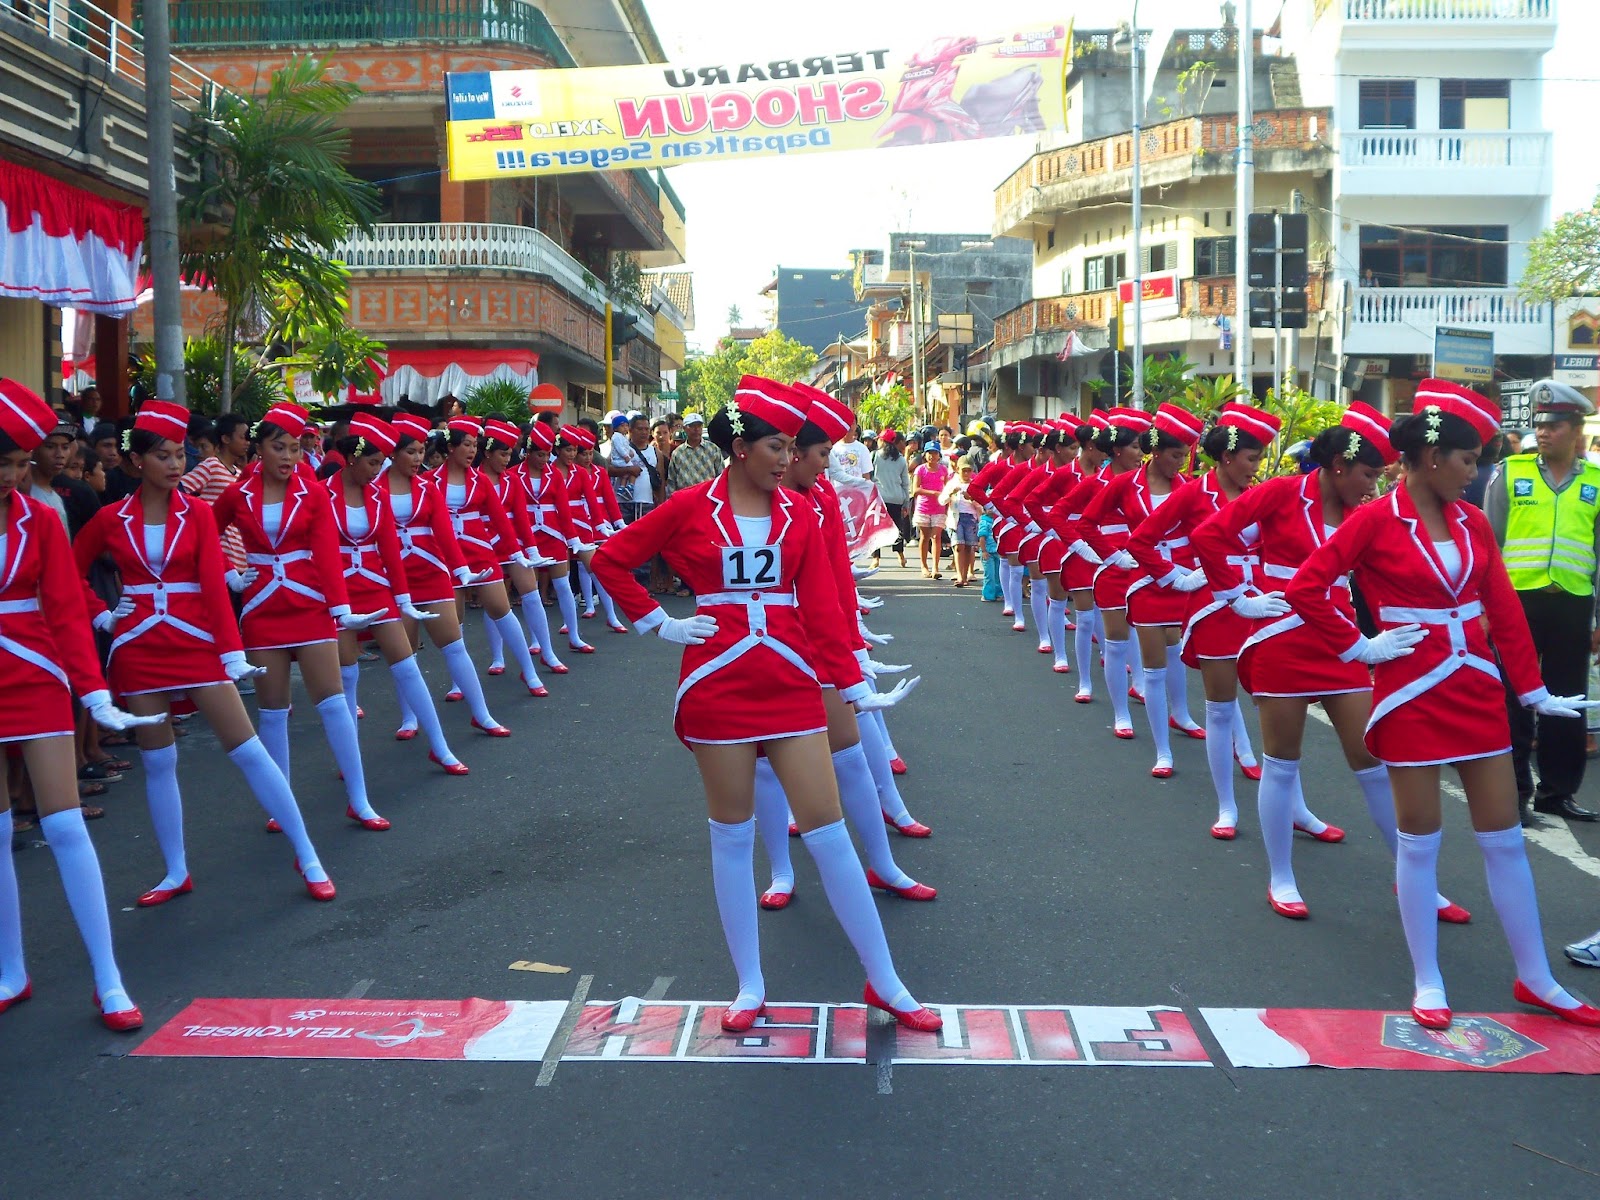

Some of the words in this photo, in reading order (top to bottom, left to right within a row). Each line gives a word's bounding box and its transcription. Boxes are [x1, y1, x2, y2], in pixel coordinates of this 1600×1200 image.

[1563, 357, 1593, 367] LEBIH
[1464, 366, 1491, 375] SUZUKI
[729, 549, 776, 585] 12
[328, 1010, 391, 1018] Indonesia
[182, 1024, 356, 1040] TELKOMSEL
[561, 1004, 1211, 1062] FINISH
